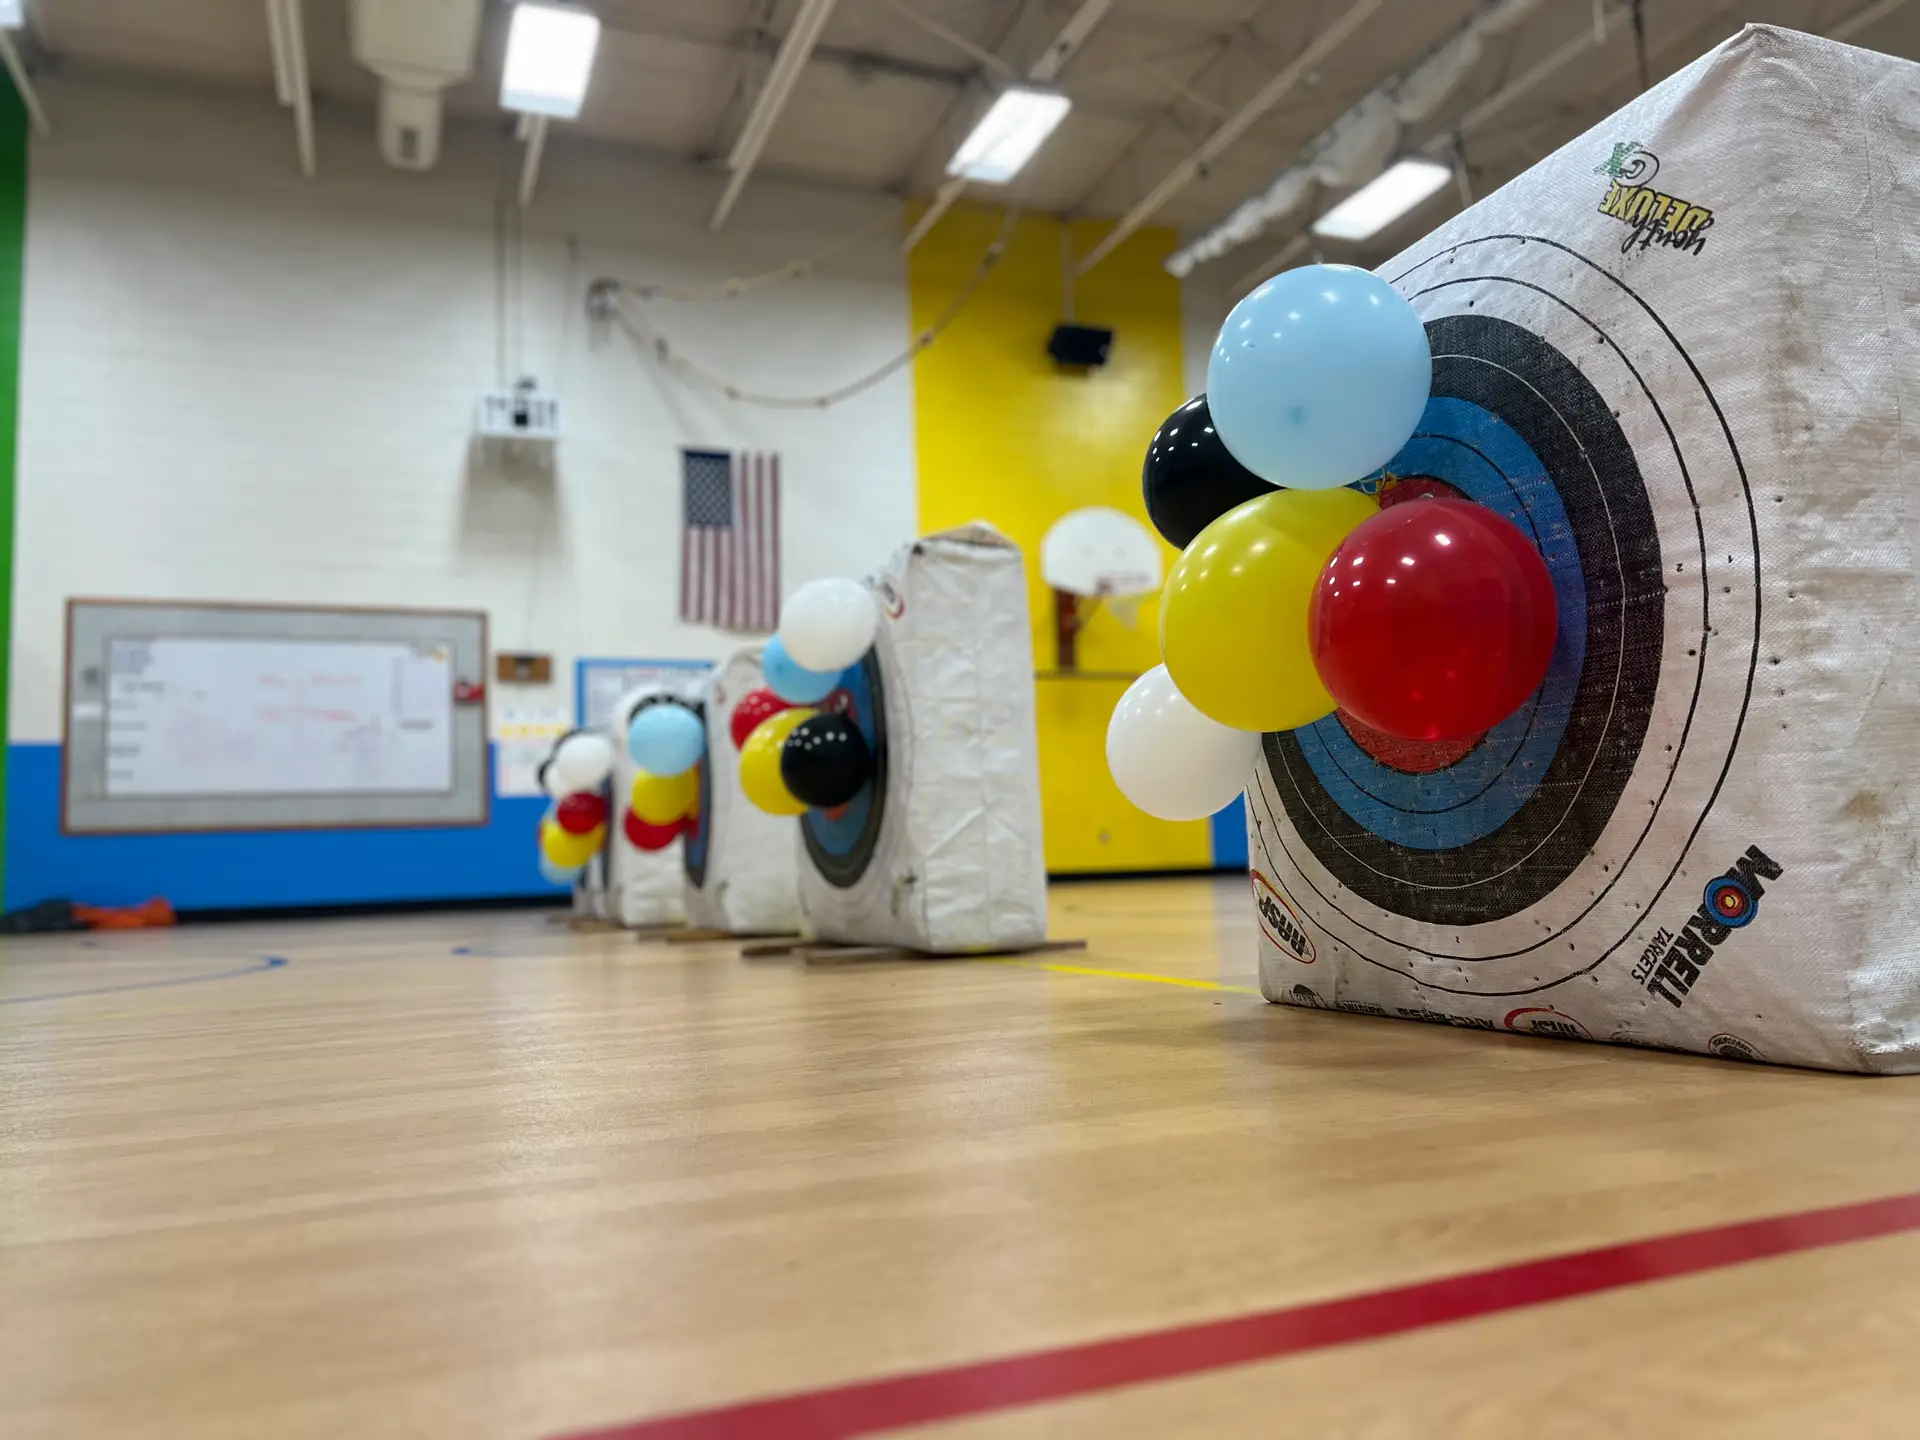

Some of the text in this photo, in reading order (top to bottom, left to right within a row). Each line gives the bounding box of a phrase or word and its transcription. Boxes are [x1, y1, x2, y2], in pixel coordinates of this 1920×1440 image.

[1598, 178, 1713, 235] DELUXE
[1258, 895, 1306, 957] NASP
[1631, 926, 1675, 986] TARGETS
